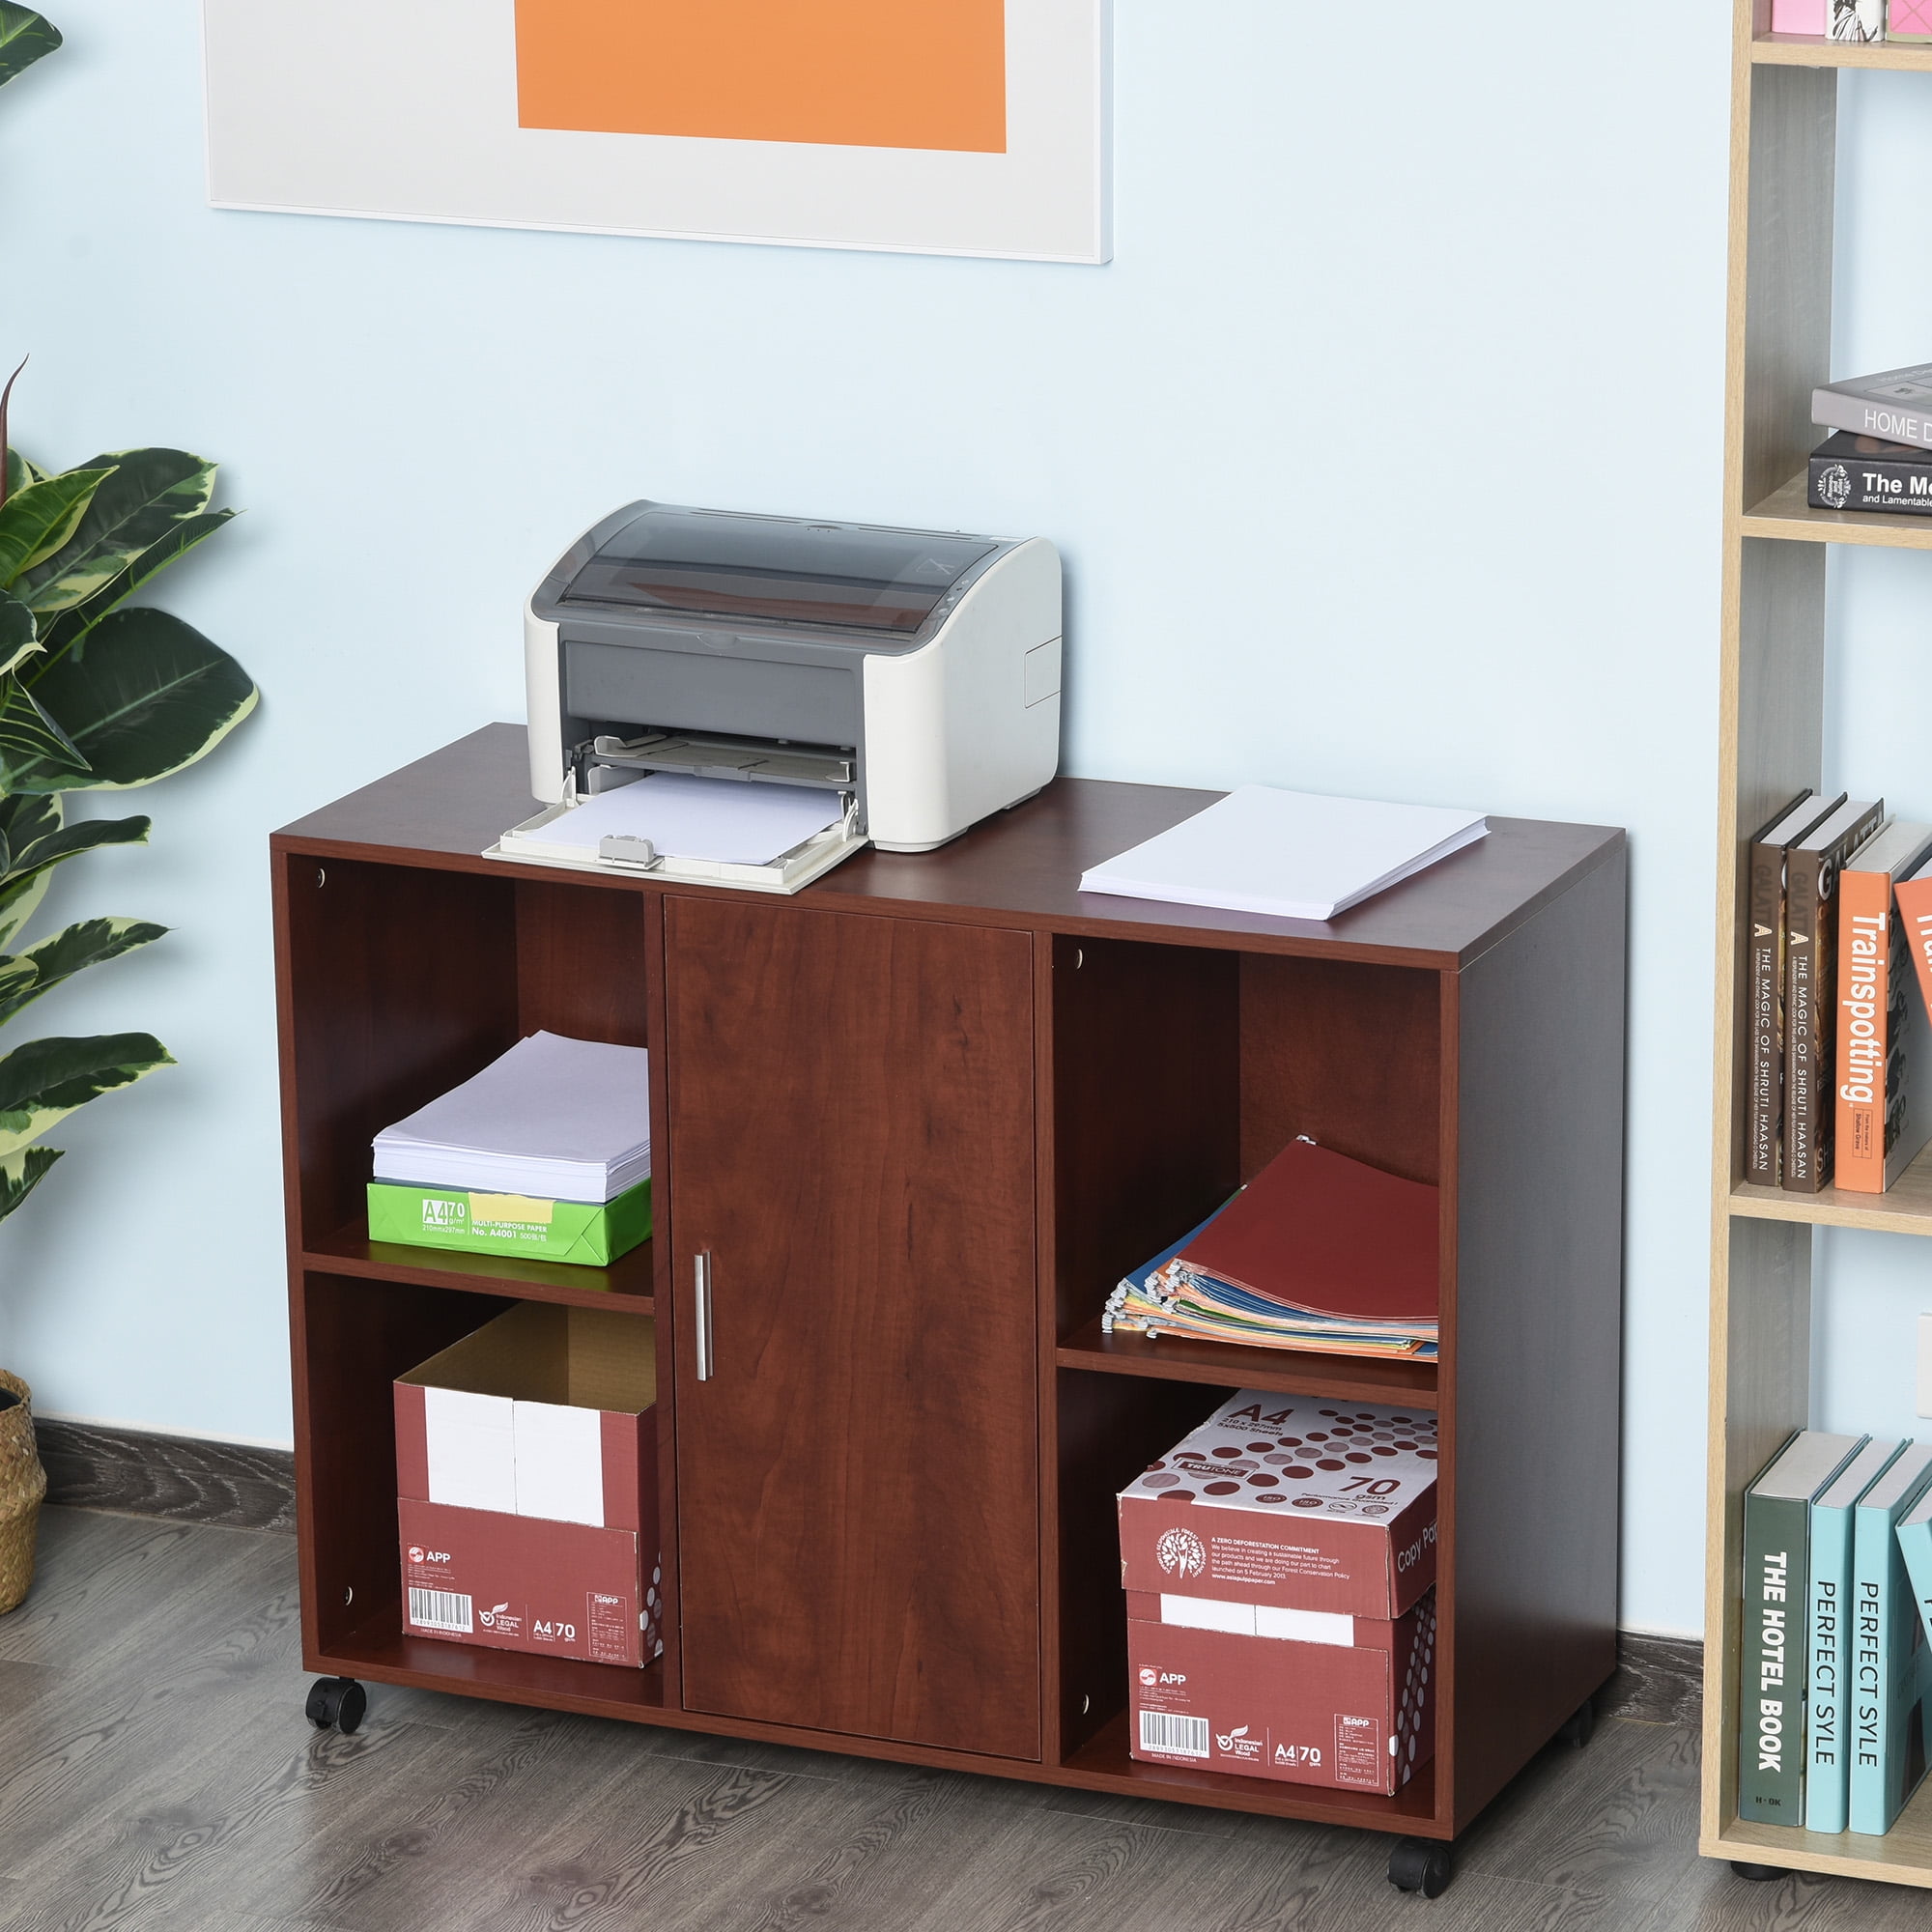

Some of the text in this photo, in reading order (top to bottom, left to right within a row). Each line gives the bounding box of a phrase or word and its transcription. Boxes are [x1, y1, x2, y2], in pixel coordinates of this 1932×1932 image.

[1864, 409, 1918, 439] HOME
[1862, 472, 1903, 494] The
[1840, 912, 1886, 1104] Trainspotting
[1759, 948, 1771, 1171] THE MAGIC OF SHRUTI HAASAN
[1797, 956, 1807, 1179] THE MAGIC OF SHRUTI HAASAN
[424, 1200, 465, 1224] A4 70
[471, 1221, 525, 1231] MULTI-PURPOSE
[472, 1228, 487, 1236] No.
[490, 1229, 517, 1238] A4001
[1227, 1404, 1295, 1425] A4
[1247, 1422, 1283, 1431] 297mm
[1250, 1427, 1283, 1436] Sheets
[1187, 1463, 1239, 1475] TRUTONE
[1338, 1476, 1401, 1495] 70
[1234, 1539, 1279, 1550] DEFORESTATION
[1280, 1545, 1320, 1554] COMMITMENT
[1247, 1548, 1267, 1556] creating
[1273, 1550, 1302, 1560] sustainable
[1398, 1538, 1421, 1573] Copy
[427, 1550, 451, 1563] APP
[1274, 1557, 1289, 1566] doing
[1211, 1565, 1236, 1574] launched
[1249, 1569, 1272, 1578] February
[1251, 1562, 1271, 1572] through
[1282, 1565, 1298, 1574] Forest
[1299, 1568, 1333, 1577] Conservation
[1334, 1571, 1350, 1580] Policy
[533, 1620, 553, 1634] A4
[555, 1623, 576, 1638] 70
[1758, 1551, 1787, 1773] THE HOTEL BOOK
[1159, 1672, 1186, 1686] APP
[1816, 1581, 1835, 1765] PERFECT SYLE
[1859, 1582, 1879, 1767] PERFECT SYLE
[1351, 1718, 1370, 1727] APP
[1235, 1738, 1263, 1747] Indonesian
[1235, 1744, 1260, 1752] LEGAL
[1275, 1744, 1295, 1759] A4
[1299, 1746, 1321, 1763] 70
